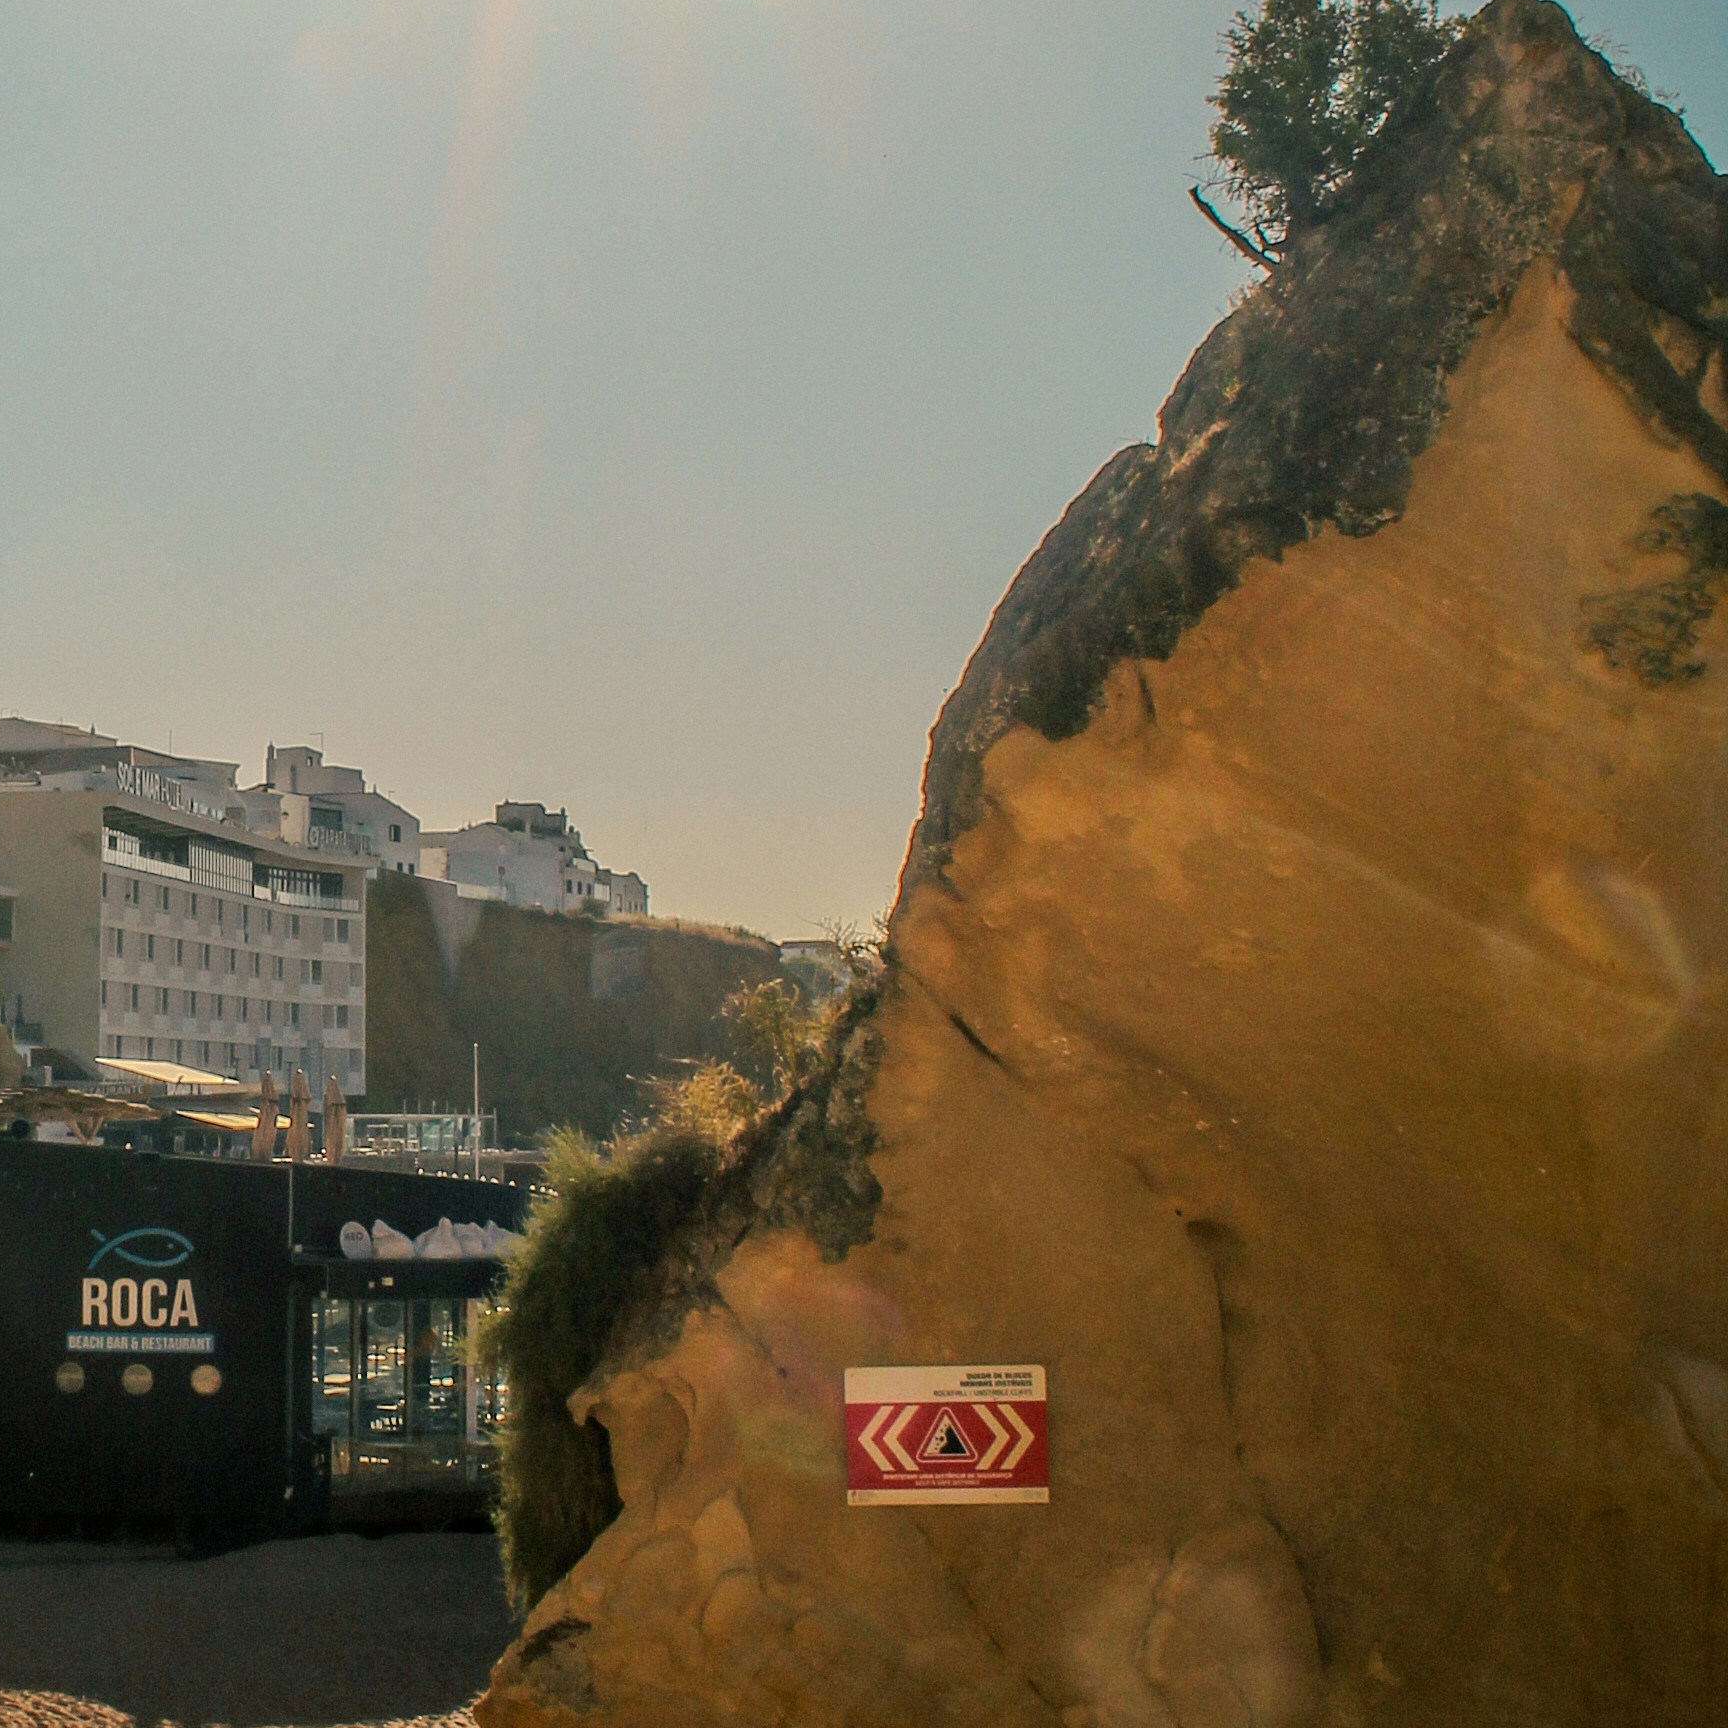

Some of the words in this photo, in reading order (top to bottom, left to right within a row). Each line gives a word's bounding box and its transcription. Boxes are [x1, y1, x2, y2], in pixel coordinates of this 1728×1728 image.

[142, 769, 161, 803] MAR
[82, 1277, 199, 1328] ROCA
[68, 1335, 104, 1349] BEACH
[106, 1336, 128, 1349] BAR
[130, 1336, 139, 1350] &
[141, 1337, 212, 1351] RESTAURANT
